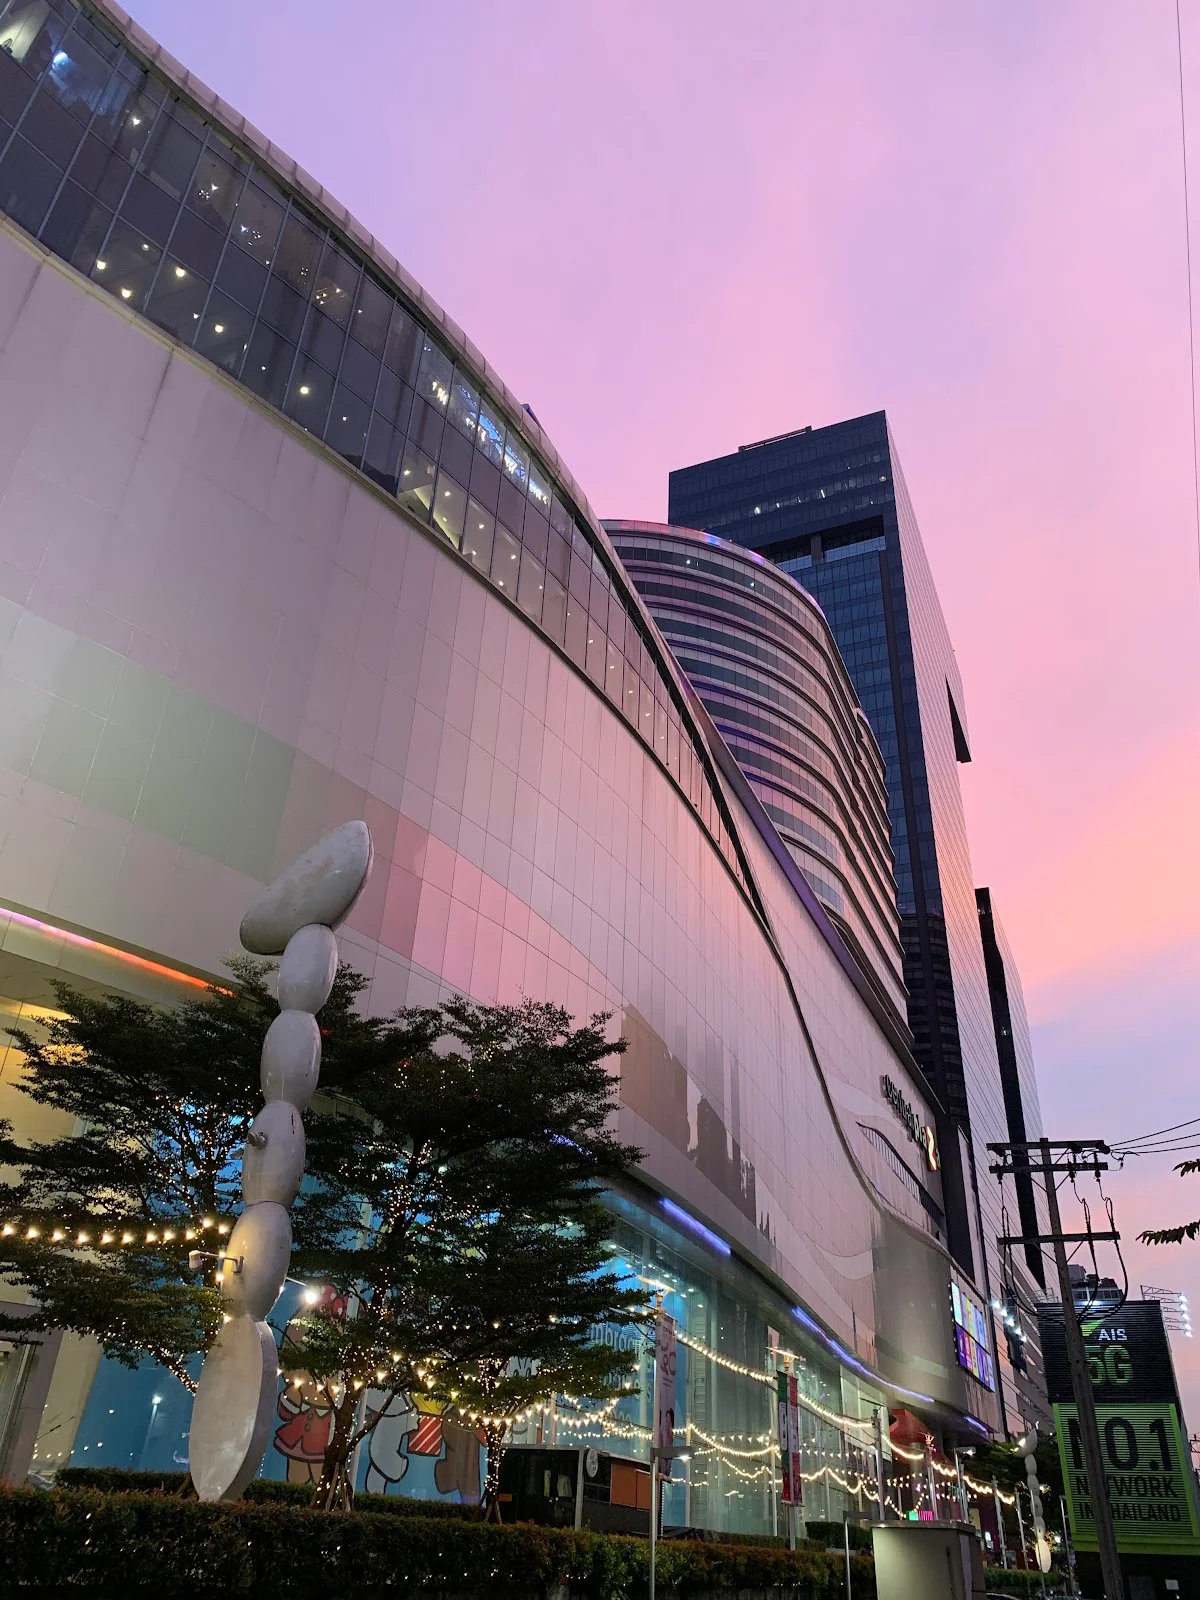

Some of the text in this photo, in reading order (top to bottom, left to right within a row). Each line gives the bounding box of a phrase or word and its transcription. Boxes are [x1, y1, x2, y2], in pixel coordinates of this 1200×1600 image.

[1099, 1329, 1128, 1341] AIS
[1084, 1345, 1133, 1384] 5G
[1076, 1475, 1177, 1497] NWORK
[1111, 1503, 1181, 1520] HAILAND
